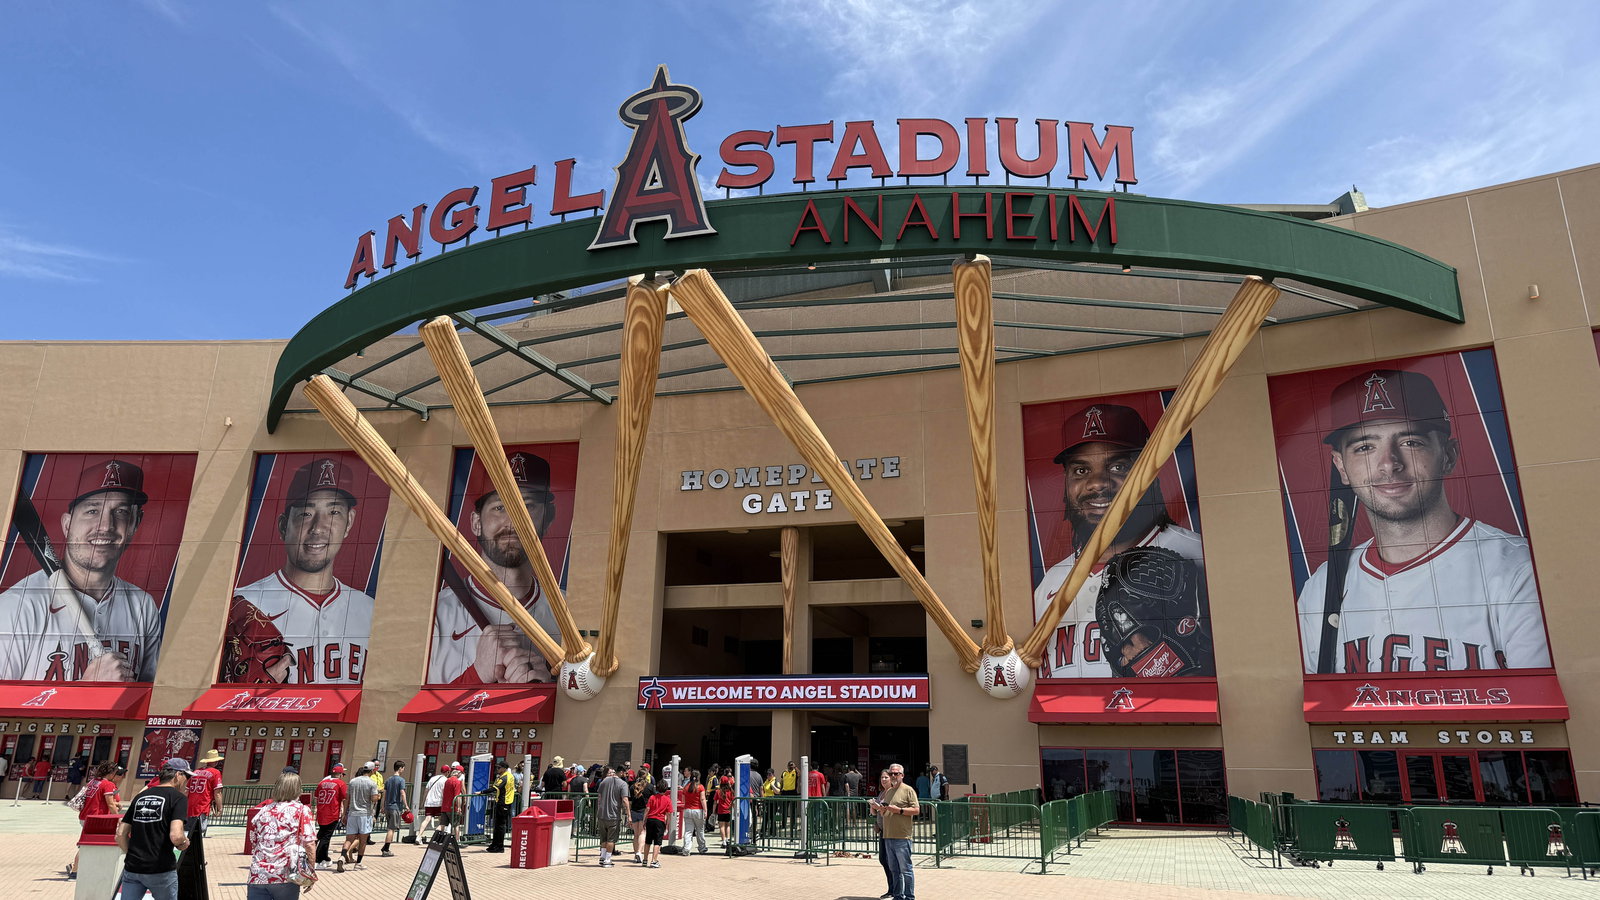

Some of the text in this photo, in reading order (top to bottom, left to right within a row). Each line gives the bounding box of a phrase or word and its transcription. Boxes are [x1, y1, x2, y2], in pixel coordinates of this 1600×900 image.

[344, 117, 1139, 289] ANGEL STADIUM
[790, 191, 1119, 246] ANAHEIM
[742, 489, 833, 515] GATE
[217, 690, 323, 711] ANGELS
[672, 684, 917, 701] WELCOME TO ANGEL STADIUM
[1352, 683, 1511, 708] ANGELS
[0, 722, 100, 734] TICKETS
[148, 717, 167, 725] 2025
[229, 726, 332, 738] TICKETS
[432, 728, 538, 739] TICKETS
[1333, 729, 1535, 745] TEAM STORE
[519, 829, 529, 868] RECYCLE
